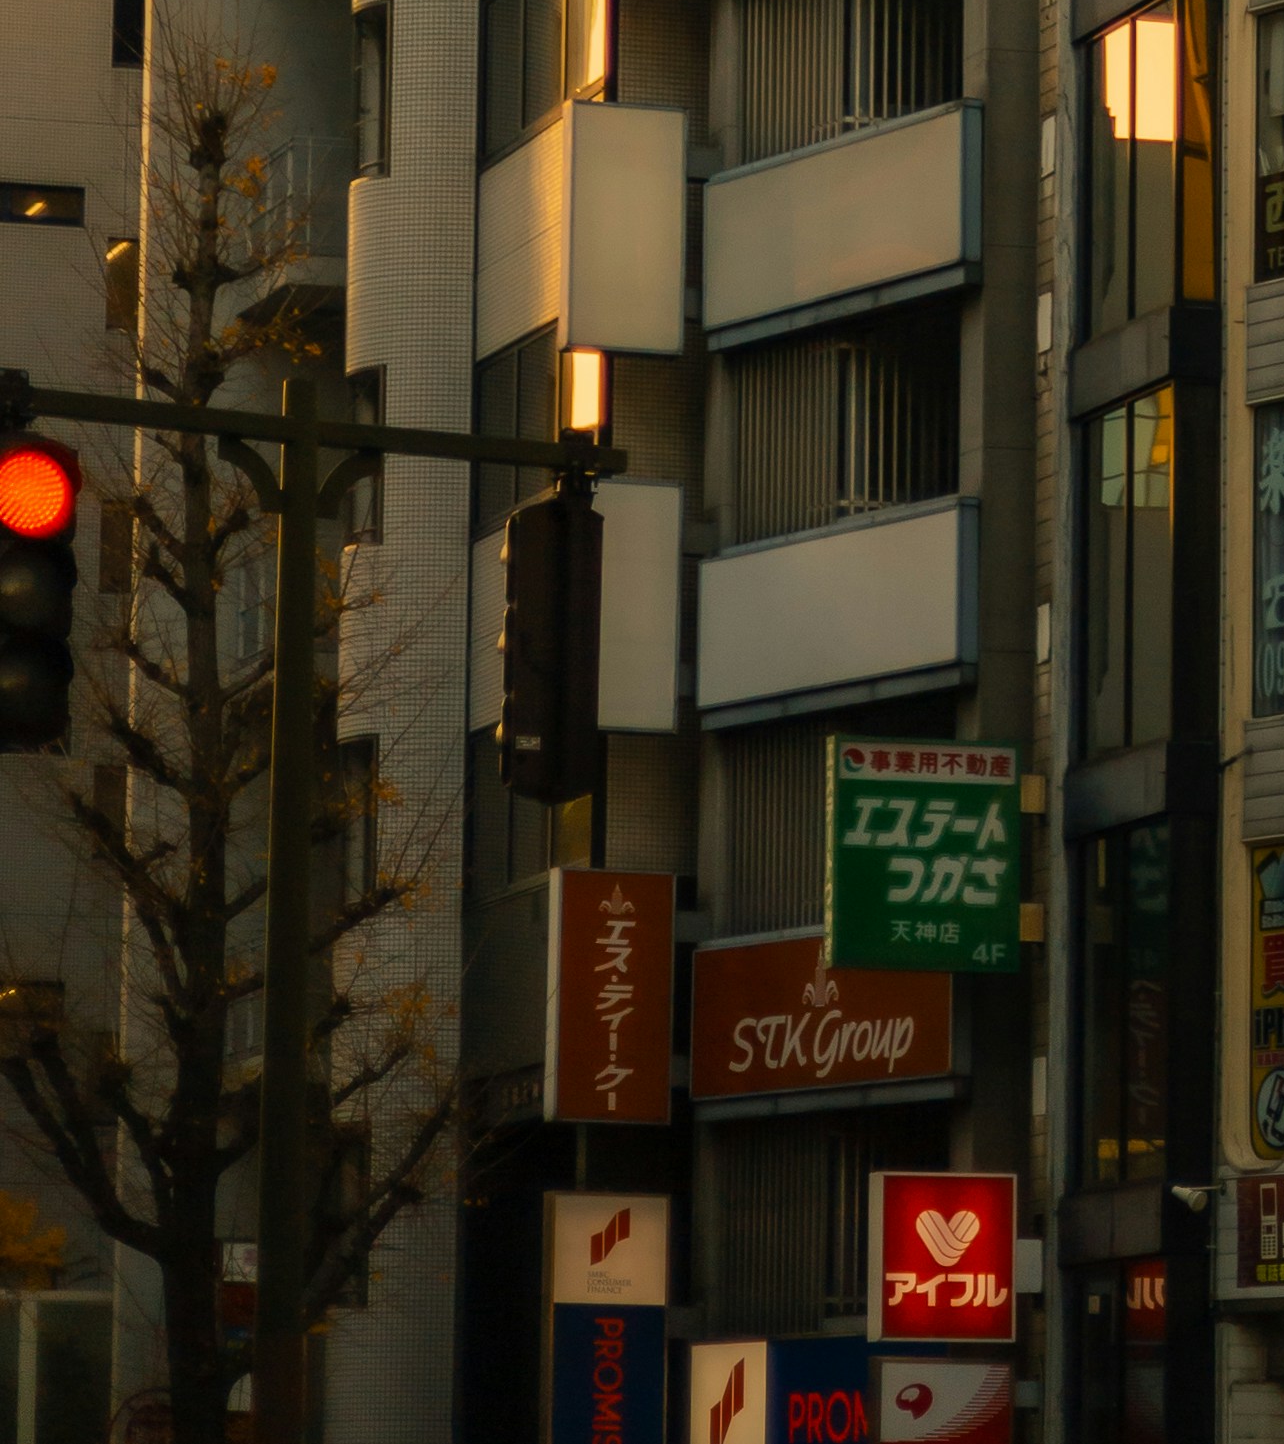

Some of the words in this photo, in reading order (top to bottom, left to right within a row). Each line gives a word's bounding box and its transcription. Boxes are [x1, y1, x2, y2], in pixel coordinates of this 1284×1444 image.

[870, 749, 1012, 778] 事業用不動産
[842, 797, 1007, 850] エステート
[890, 920, 961, 944] 天神店
[972, 943, 1007, 965] 4F
[595, 920, 635, 1110] エス・ティー・ケー
[728, 1013, 813, 1072] STK
[814, 1009, 915, 1079] Group
[885, 1272, 1008, 1309] アイフル
